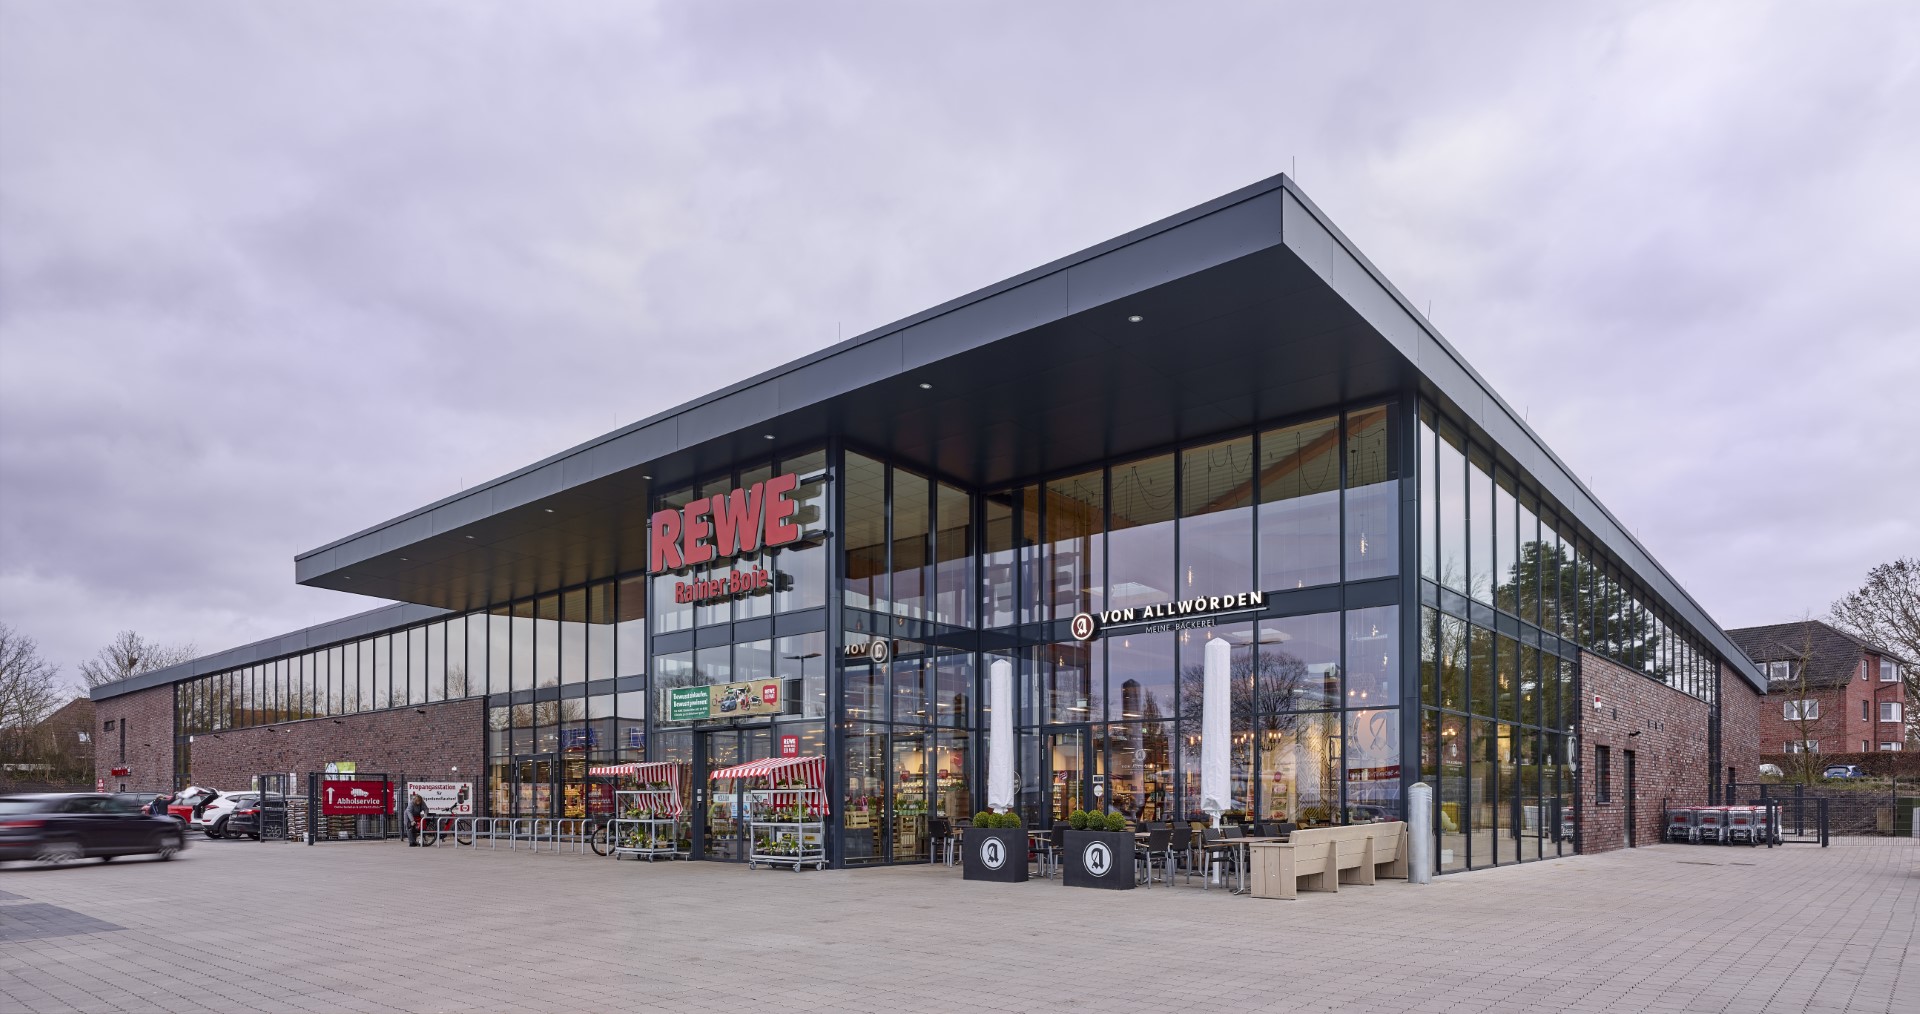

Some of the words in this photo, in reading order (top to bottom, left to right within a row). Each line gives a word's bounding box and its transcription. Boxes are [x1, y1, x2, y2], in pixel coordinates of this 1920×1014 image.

[651, 472, 800, 574] REWE
[674, 577, 727, 604] Rainer
[729, 564, 769, 594] Boie
[1100, 608, 1135, 624] VON
[1143, 590, 1262, 619] ALLWÖRDEN
[1145, 624, 1171, 634] MEINE
[1175, 619, 1216, 630] BÄCKEREI
[337, 797, 380, 805] Abholservice
